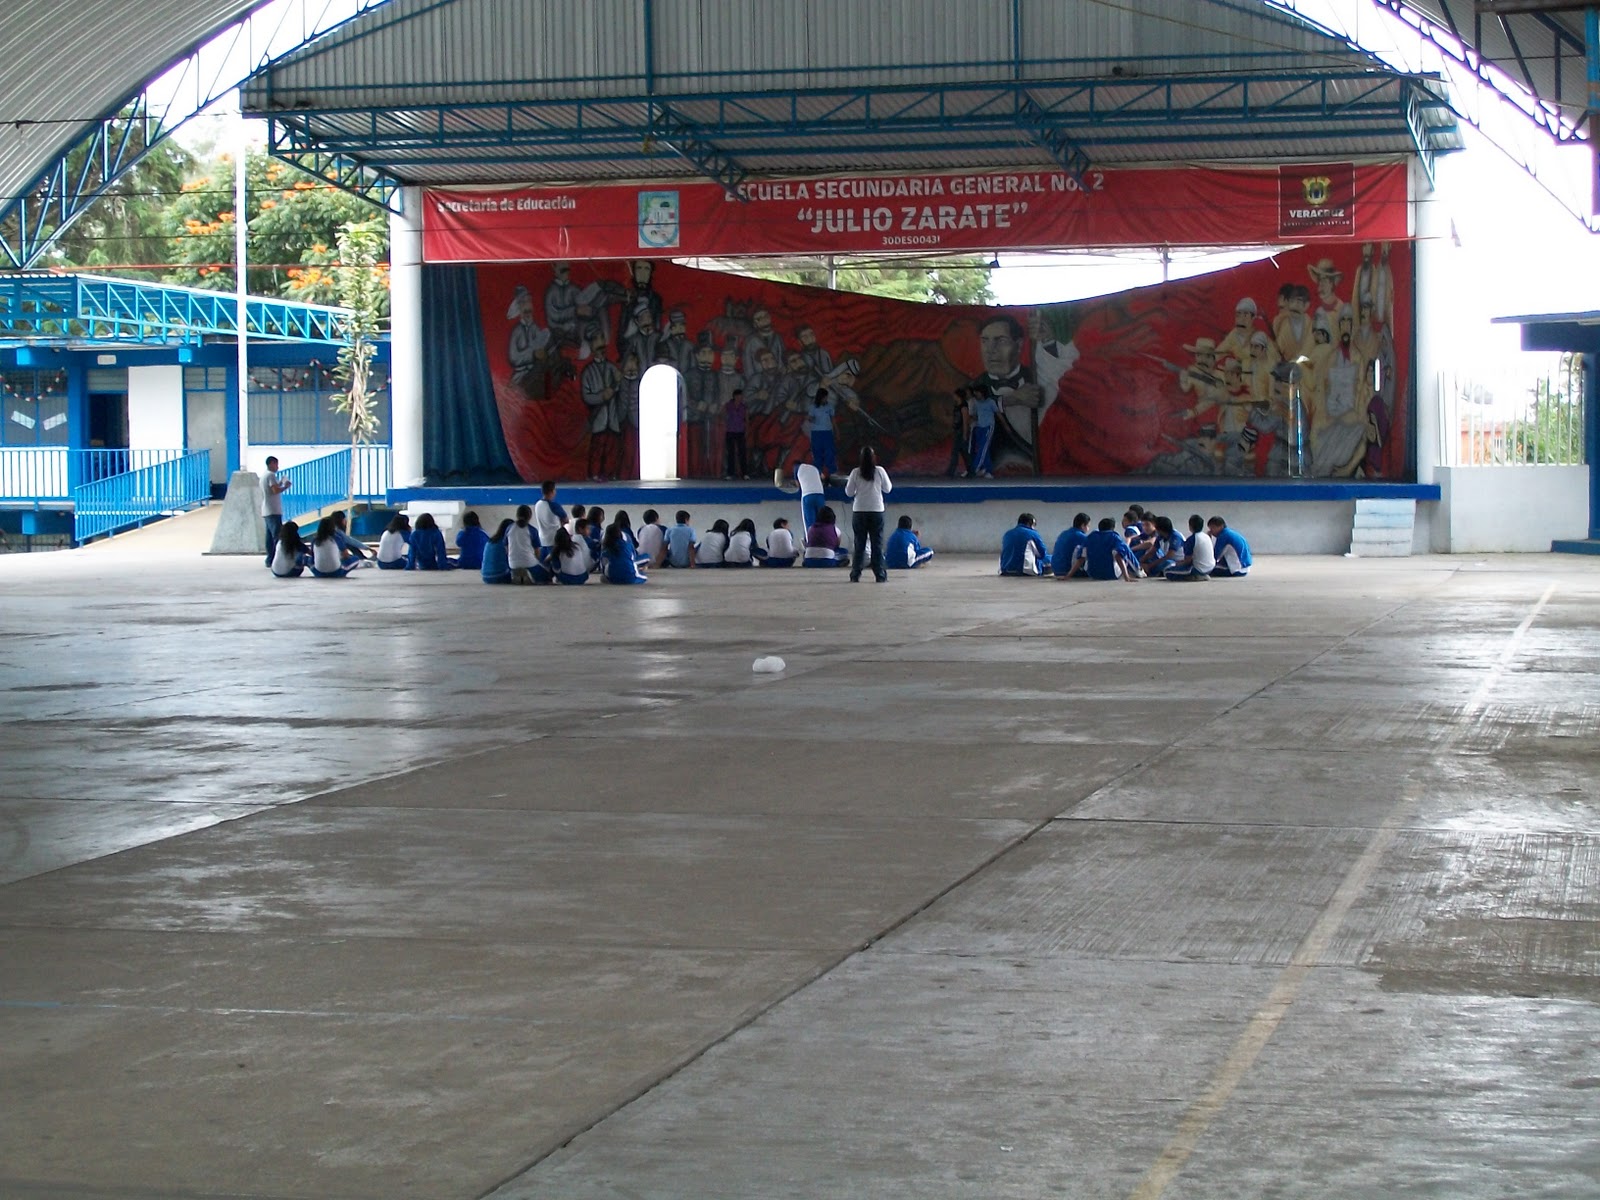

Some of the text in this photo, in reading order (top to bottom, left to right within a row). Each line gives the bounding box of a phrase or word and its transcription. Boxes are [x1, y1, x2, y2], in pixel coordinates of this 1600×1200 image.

[815, 178, 945, 199] SECUNDARIA
[950, 174, 1045, 195] GENERAL
[1092, 172, 1104, 190] 2
[500, 197, 514, 211] de
[517, 196, 576, 211] Educación
[1289, 208, 1345, 218] VERACRUZ
